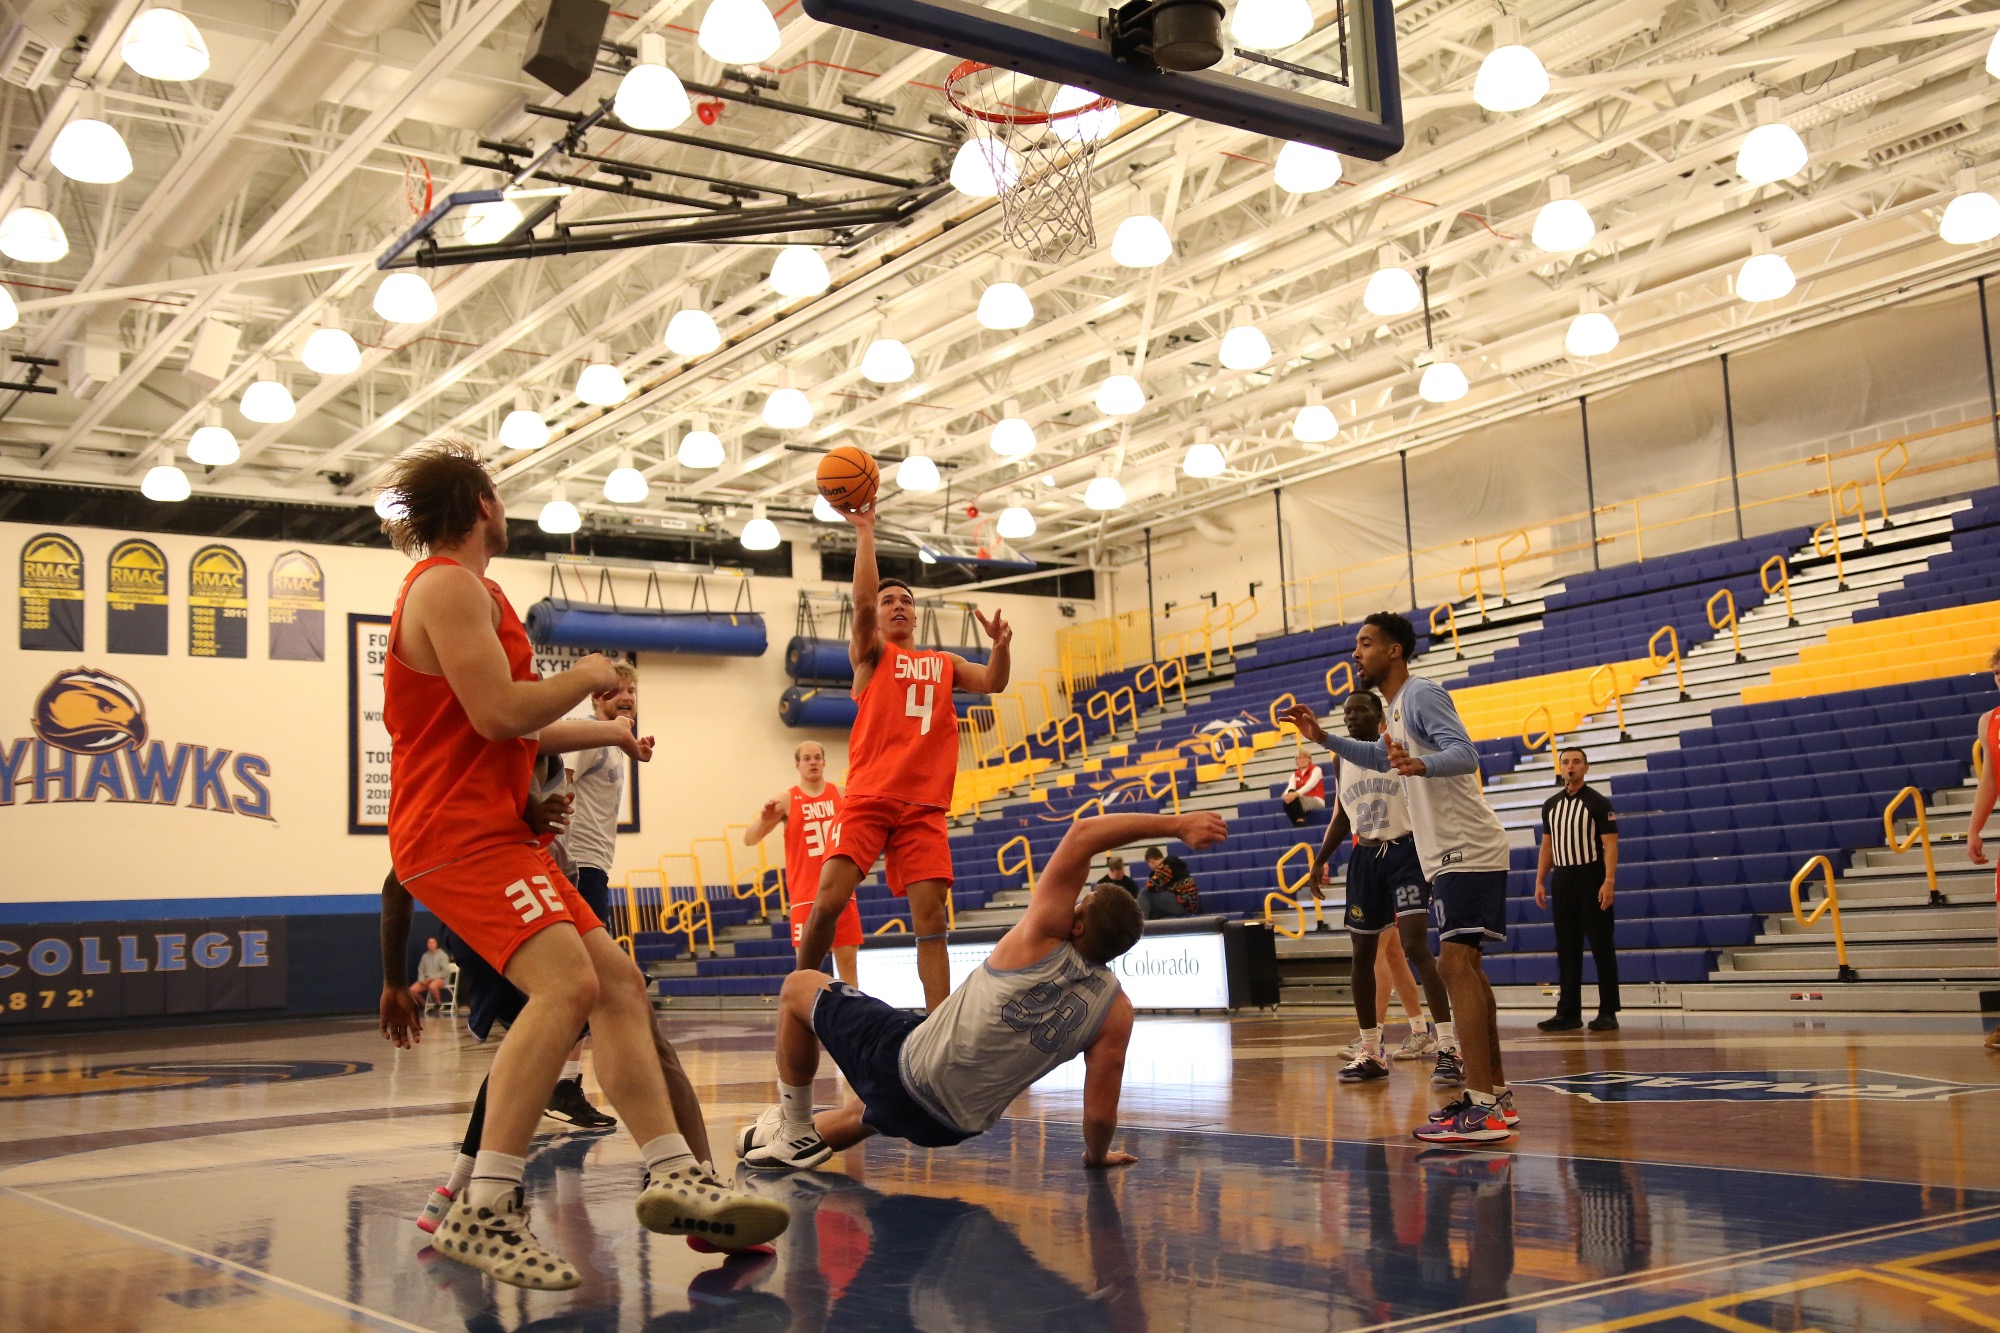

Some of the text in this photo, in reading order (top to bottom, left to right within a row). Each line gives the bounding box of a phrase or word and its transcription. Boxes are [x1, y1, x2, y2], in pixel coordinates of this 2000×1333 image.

[24, 563, 80, 579] RMAC
[111, 567, 164, 585] RMAC
[192, 572, 243, 588] RMAC
[273, 577, 319, 592] RMAC
[223, 608, 247, 618] 2011
[894, 654, 943, 684] SNOW
[905, 683, 934, 736] 4
[365, 773, 391, 784] 200
[1342, 777, 1400, 806] SKYHAWKS
[801, 799, 835, 820] SNOW
[1355, 798, 1390, 833] 22
[831, 822, 842, 848] 4
[504, 875, 564, 924] 32
[1395, 884, 1422, 907] 22
[1122, 949, 1199, 977] Colorado
[1001, 980, 1088, 1054] 33
[670, 1216, 736, 1236] BOOST
